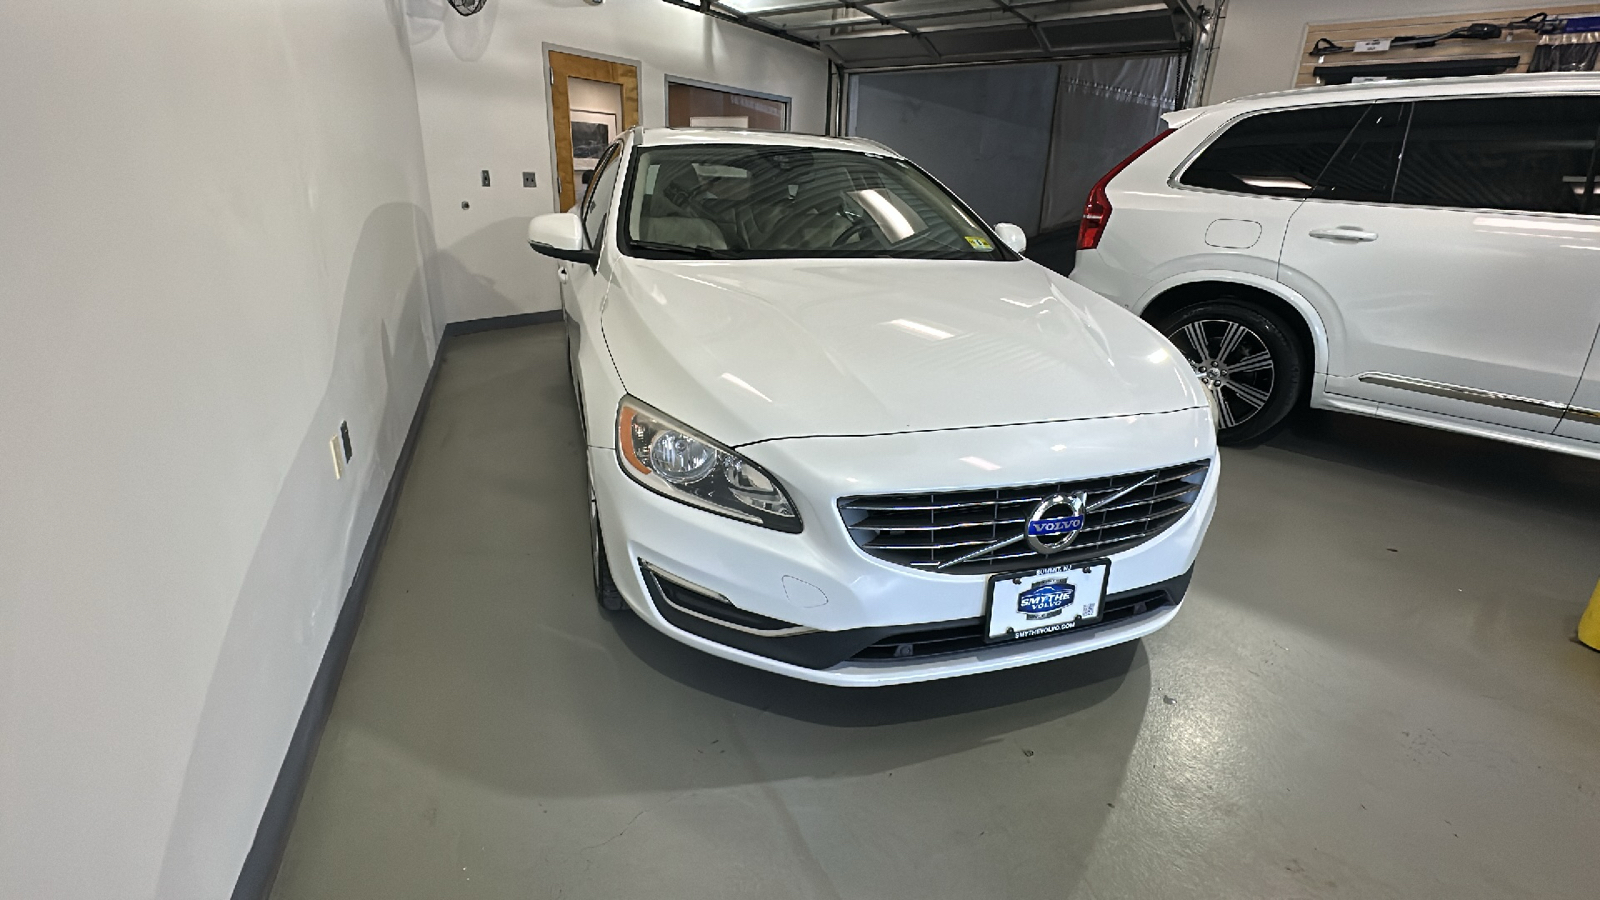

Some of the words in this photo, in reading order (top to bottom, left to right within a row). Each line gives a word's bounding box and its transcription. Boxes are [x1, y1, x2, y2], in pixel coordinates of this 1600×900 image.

[1032, 519, 1081, 532] VOLVO
[1021, 593, 1070, 607] SMYTHE
[1031, 600, 1062, 610] VOLVO
[1014, 621, 1076, 639] SMYTHEVOLVO.COM
